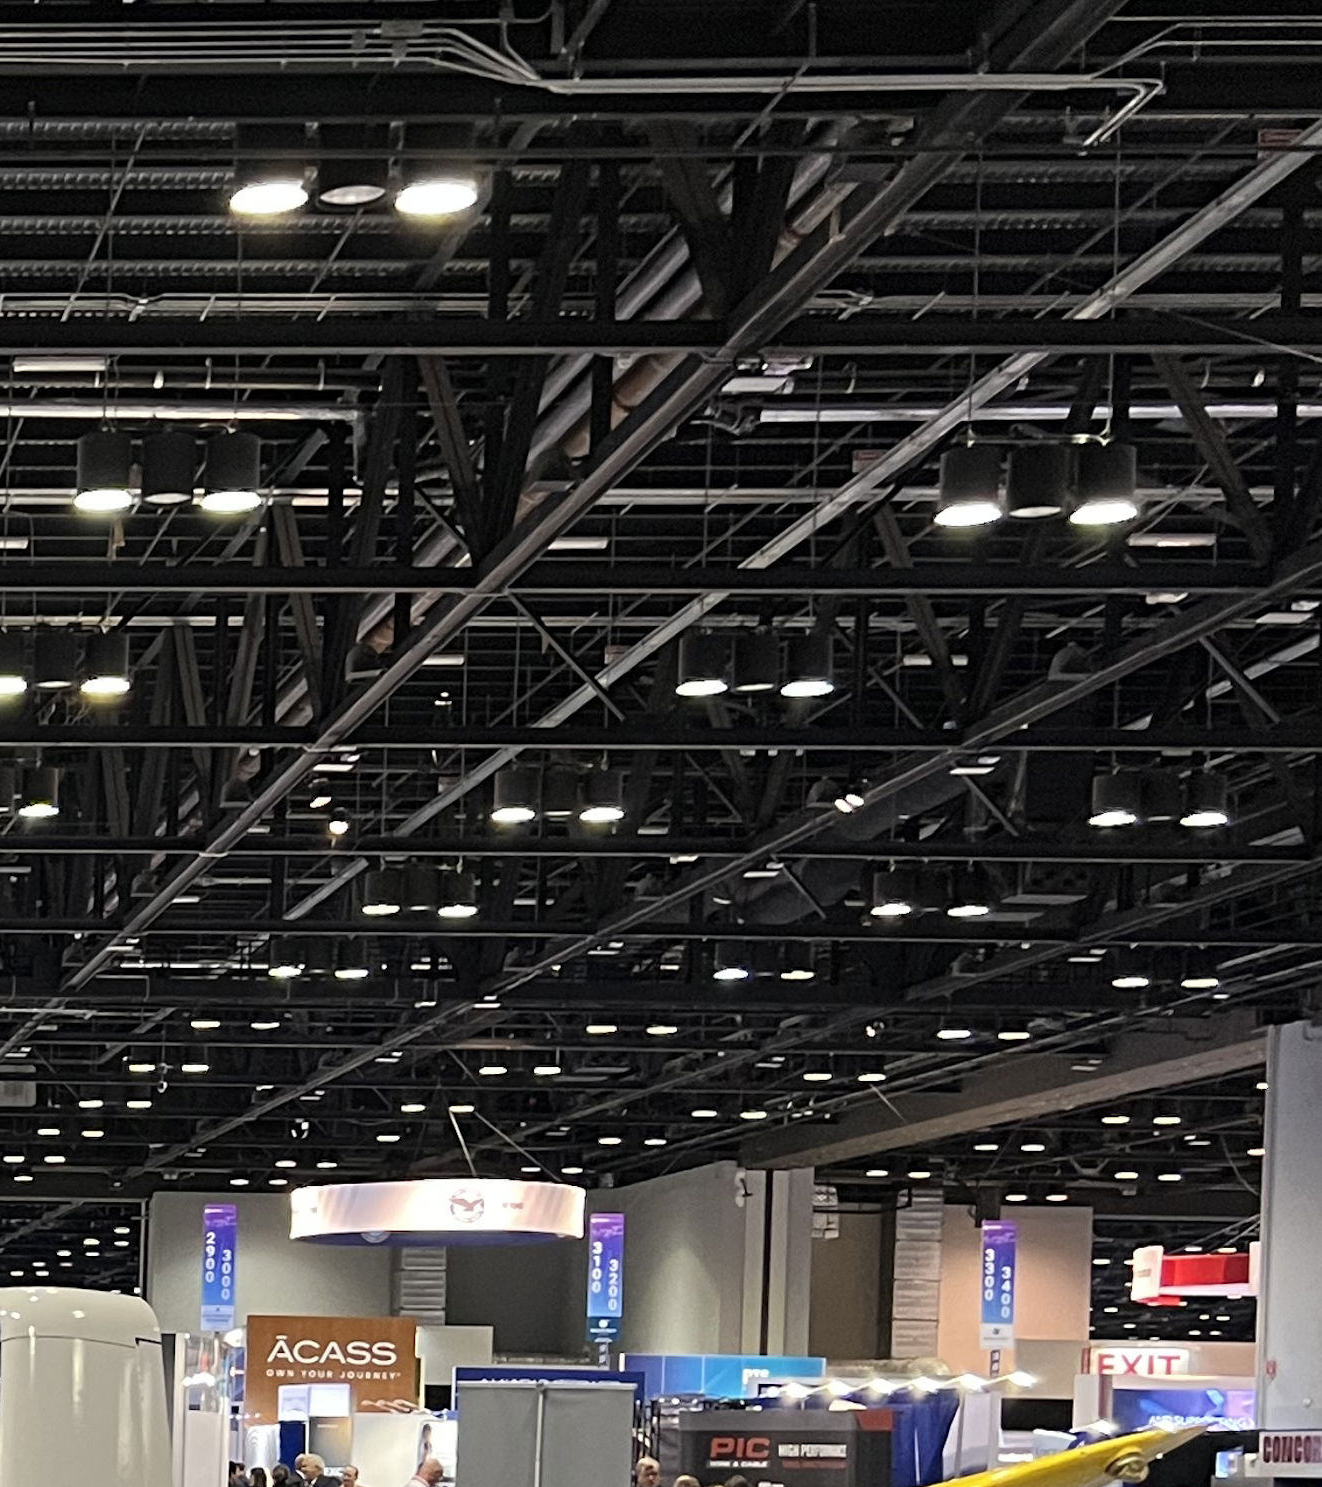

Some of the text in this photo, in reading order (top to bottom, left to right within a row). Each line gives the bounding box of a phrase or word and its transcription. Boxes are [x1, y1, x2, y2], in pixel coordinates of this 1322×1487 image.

[205, 1231, 216, 1283] 2900
[221, 1249, 232, 1300] 3000
[591, 1241, 603, 1294] 3100
[984, 1248, 995, 1301] 3300
[608, 1259, 619, 1311] 3200
[1000, 1266, 1012, 1318] 3400
[265, 1368, 295, 1378] OWN
[301, 1369, 334, 1379] YOUR
[1098, 1353, 1181, 1375] EXIT
[710, 1437, 771, 1459] PIC
